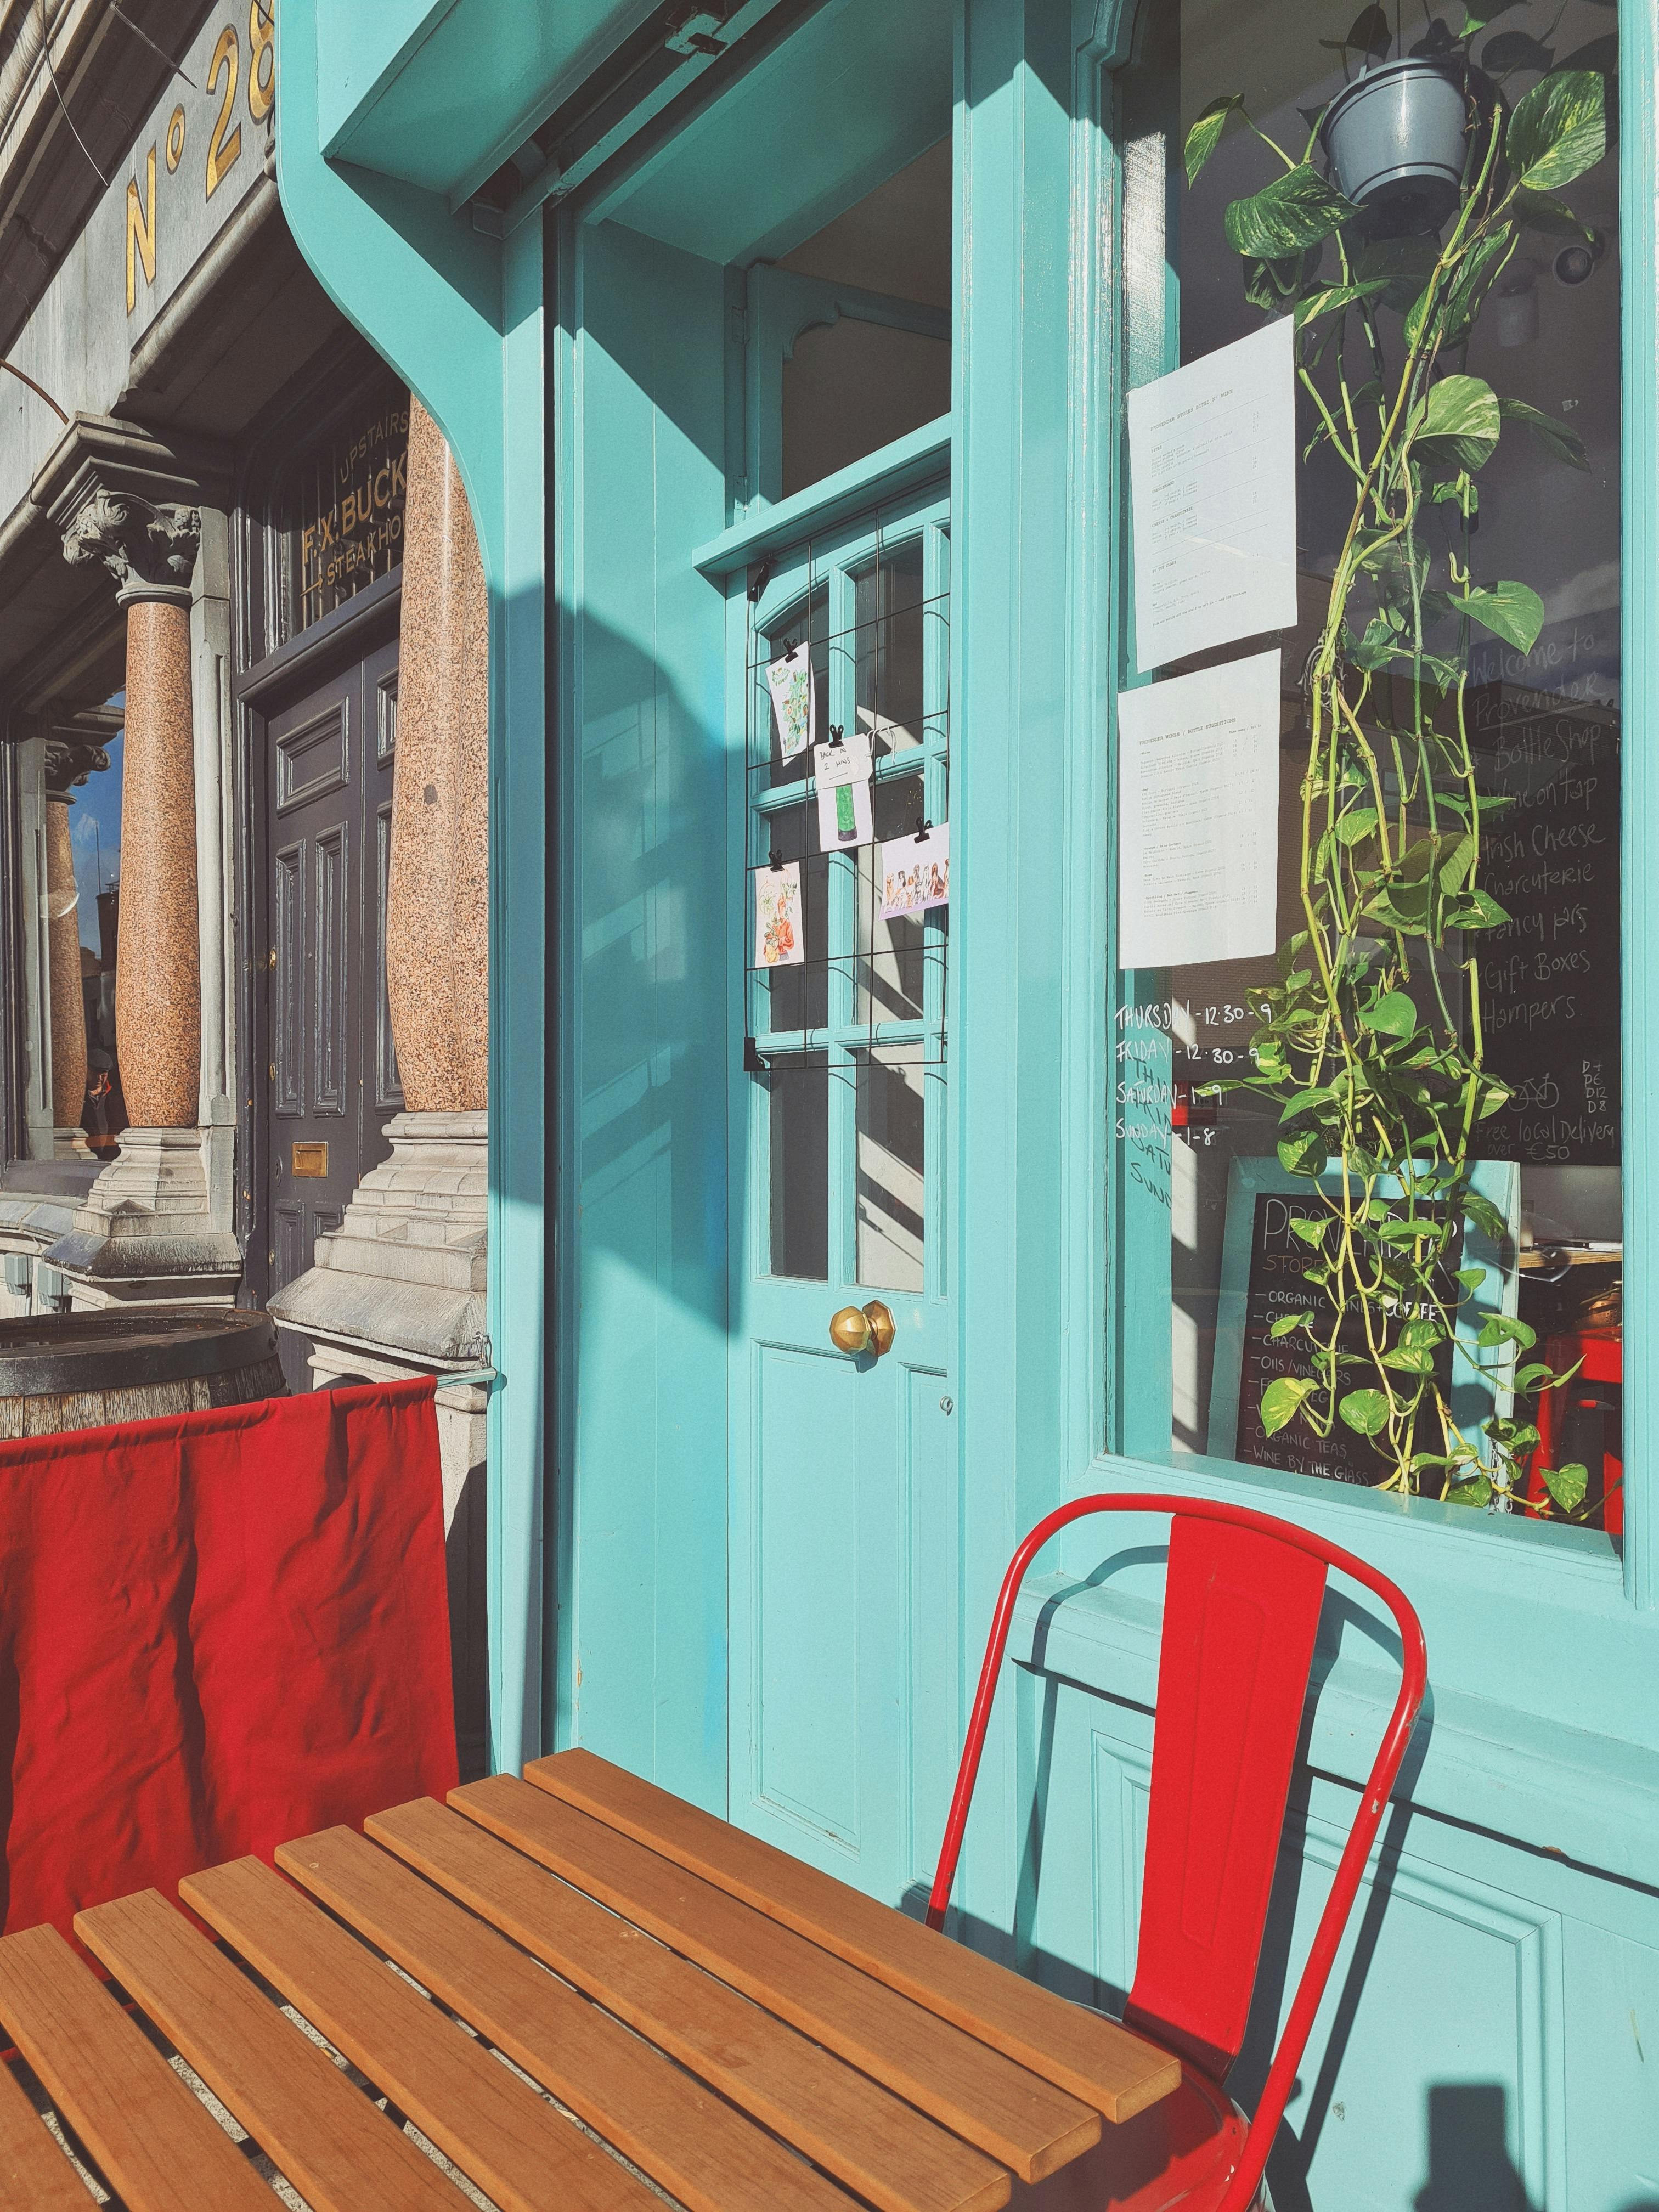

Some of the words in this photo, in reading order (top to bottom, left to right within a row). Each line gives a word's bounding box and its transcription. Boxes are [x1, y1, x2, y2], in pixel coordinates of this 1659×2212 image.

[1177, 408, 1194, 420] STORES
[1195, 399, 1210, 410] BITES
[1221, 388, 1233, 398] WINE
[340, 411, 409, 483] UPSTAIRS
[327, 509, 406, 585] STEAKHO
[1474, 642, 1563, 689] Welcome
[1567, 627, 1594, 662] to
[819, 750, 835, 760] BACK
[1493, 726, 1554, 772] Bottle
[1556, 719, 1601, 766] Shop
[824, 763, 830, 771] 2
[836, 757, 850, 767] MINS
[1537, 782, 1557, 806] on
[1485, 831, 1525, 866] Irish
[1531, 823, 1607, 856] Cheese
[1484, 955, 1528, 995] Gift
[1534, 949, 1591, 981] Boxes
[1114, 999, 1190, 1030] THURSDAY
[1482, 995, 1576, 1034] Hampers
[1116, 1039, 1169, 1063] FRIDAY
[1116, 1080, 1177, 1110] SATURDAY
[1585, 1087, 1609, 1098] D12
[1116, 1118, 1168, 1149] SUNDAY
[1474, 1122, 1510, 1142] Free
[1560, 1115, 1615, 1148] Delivery
[1487, 1143, 1515, 1155] over
[1525, 1142, 1570, 1160] €50
[1268, 1290, 1326, 1308] ORGANIC
[1255, 1425, 1311, 1449] OGANIC
[1316, 1440, 1347, 1458] TEAS
[1253, 1445, 1282, 1465] WINE
[1288, 1454, 1305, 1473] BY
[1308, 1461, 1330, 1476] THE
